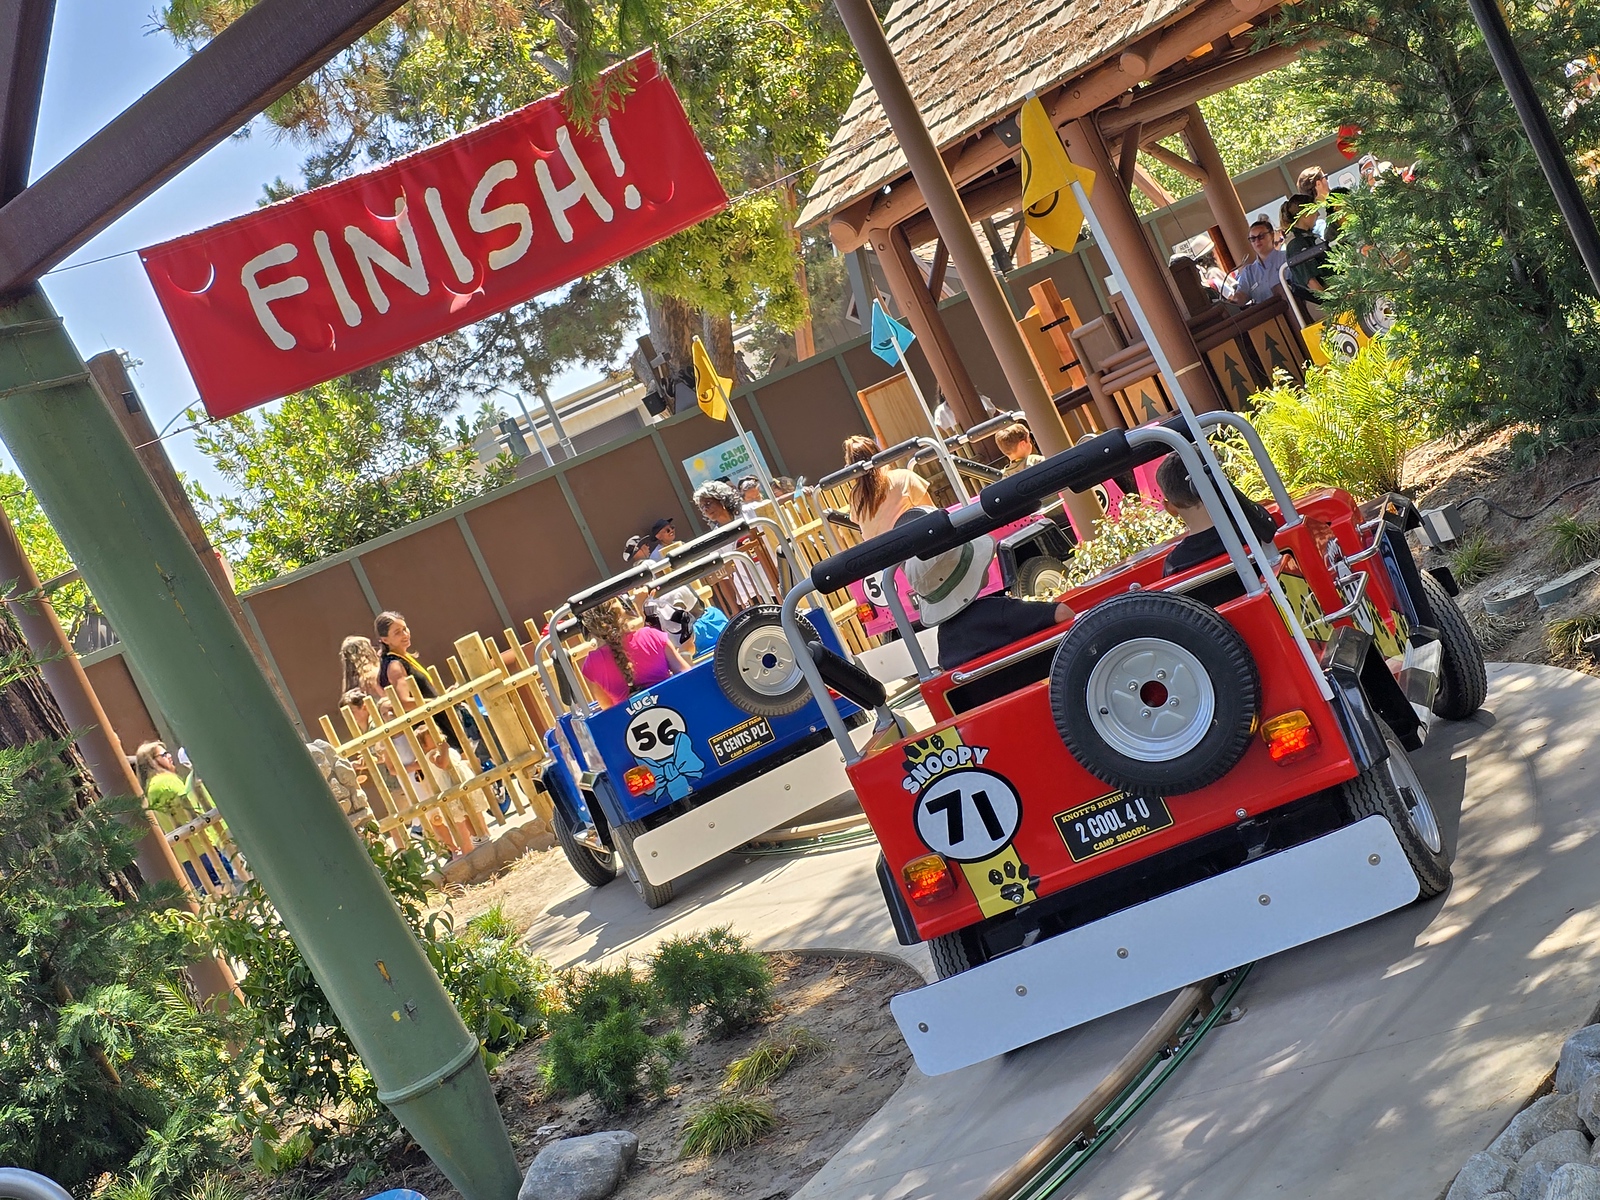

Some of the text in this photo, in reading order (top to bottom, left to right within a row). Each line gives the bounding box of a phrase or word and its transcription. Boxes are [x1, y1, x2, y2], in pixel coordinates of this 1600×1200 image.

[241, 117, 642, 351] FINISH!
[718, 452, 750, 473] SNOOP
[720, 444, 747, 462] CAMP
[865, 576, 885, 598] 5
[625, 694, 659, 716] LUCY
[630, 717, 680, 752] 56
[714, 722, 769, 757] 5 CENTS PLZ
[902, 745, 989, 795] SNOOPY
[925, 788, 1006, 846] 71
[1061, 793, 1125, 823] KNOTT'S BERRY
[1074, 797, 1150, 844] 2 COOL 4 U
[1092, 838, 1115, 851] CAMP
